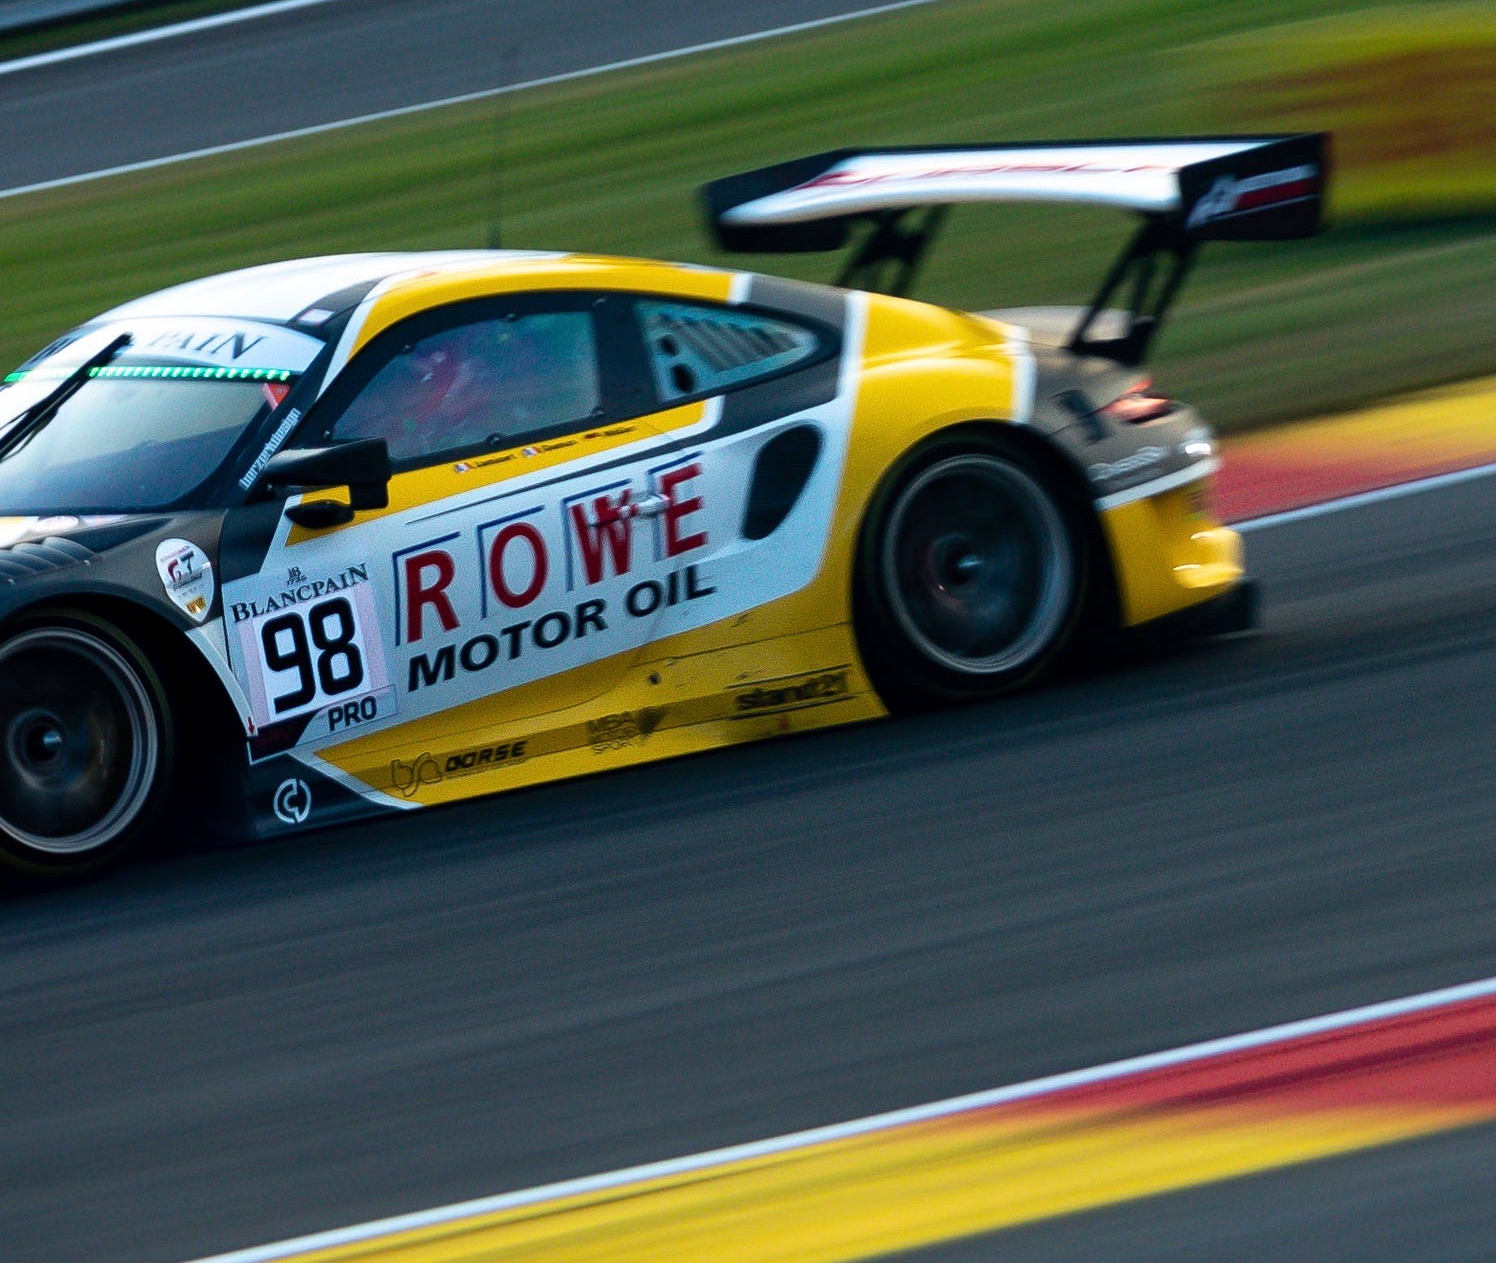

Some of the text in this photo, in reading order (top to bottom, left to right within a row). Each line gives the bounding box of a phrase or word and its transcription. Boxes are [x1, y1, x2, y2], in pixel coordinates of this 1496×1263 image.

[230, 562, 370, 623] BLANCPAIN
[405, 462, 709, 644] ROWE
[261, 596, 363, 715] 98
[407, 564, 718, 692] MOTOR OIL
[328, 695, 377, 731] PRO
